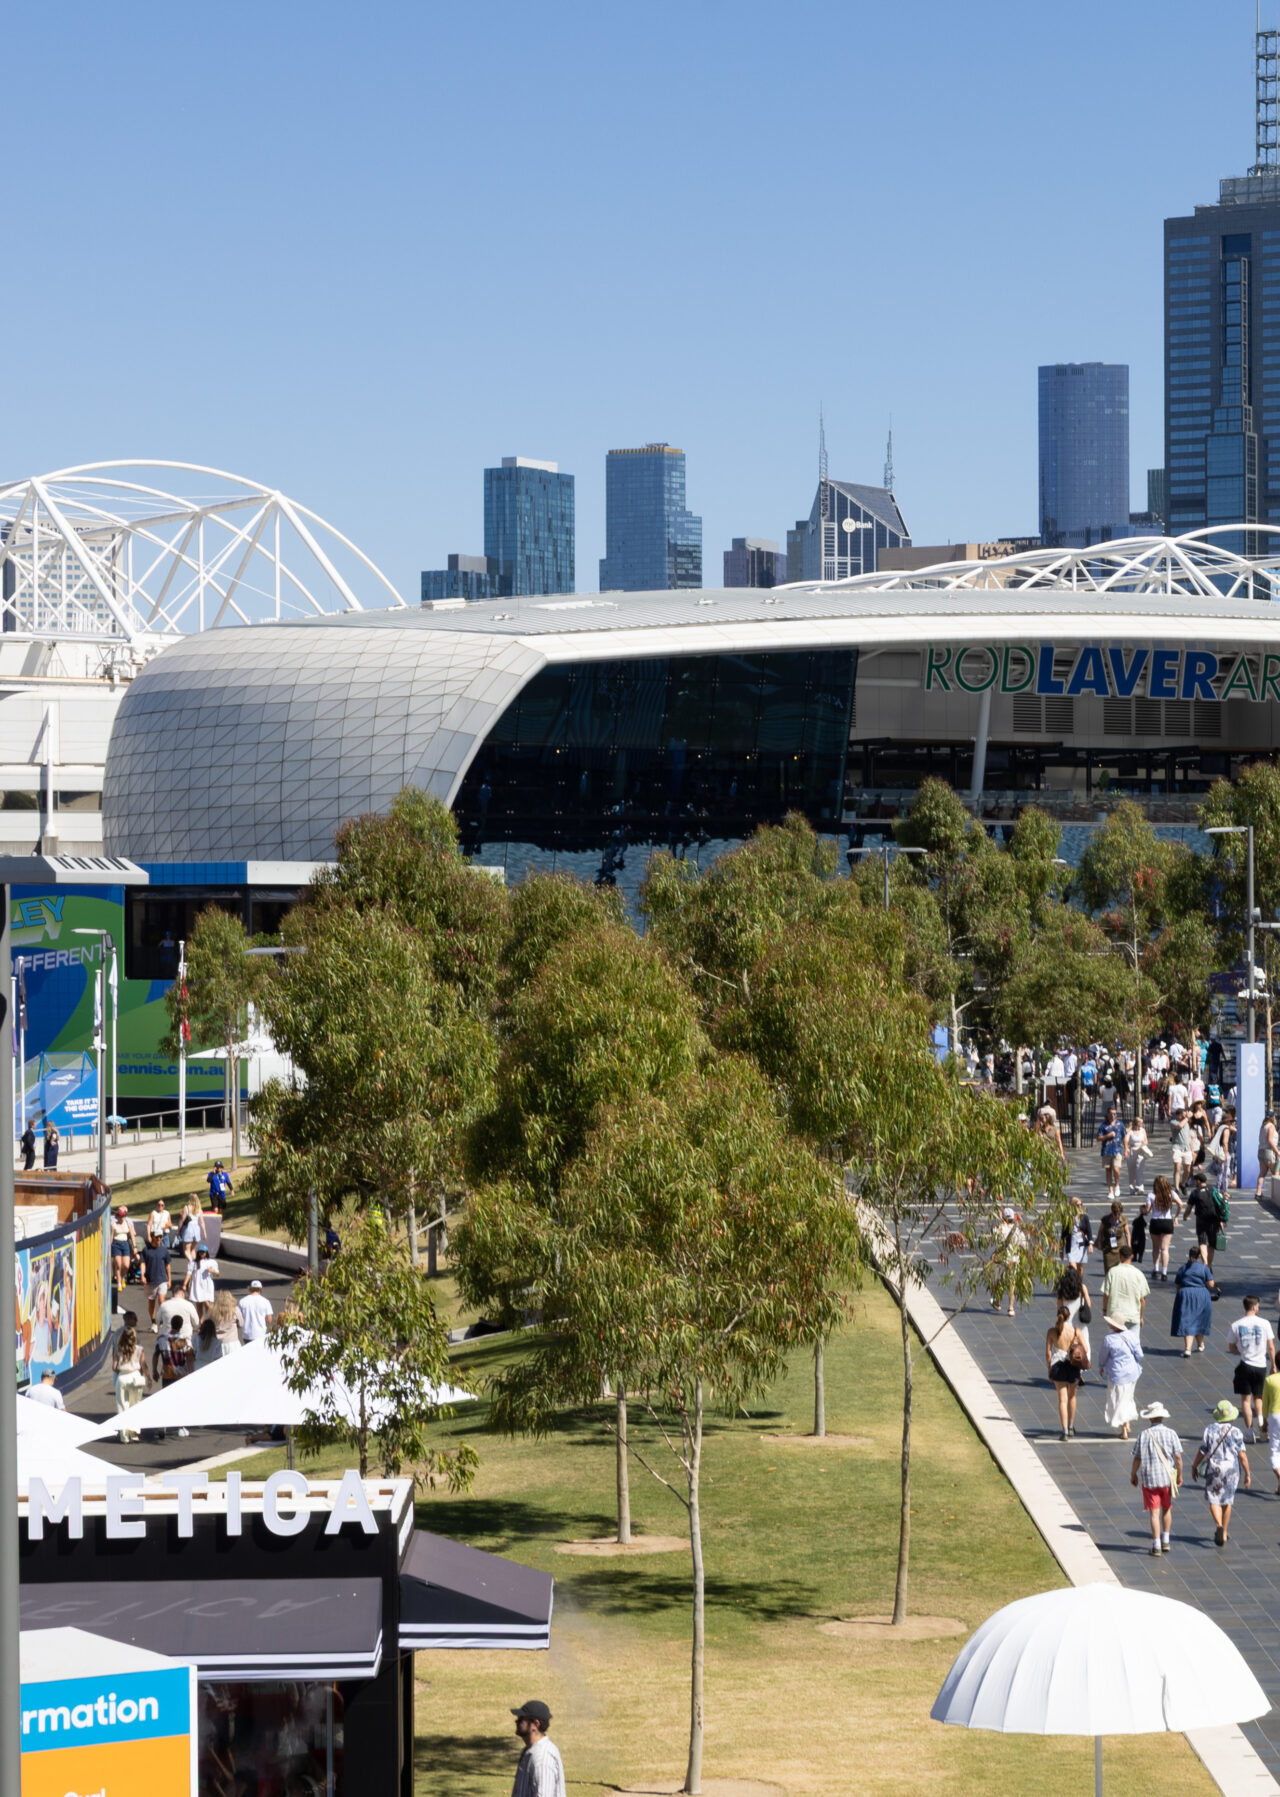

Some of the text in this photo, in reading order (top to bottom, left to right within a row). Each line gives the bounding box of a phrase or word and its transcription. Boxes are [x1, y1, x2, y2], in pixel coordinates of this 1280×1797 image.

[856, 521, 873, 529] Bank
[925, 646, 1036, 694] ROD
[1036, 646, 1220, 700] LAVER
[10, 895, 66, 931] EY
[28, 1469, 380, 1541] METICA
[21, 1692, 159, 1735] rmation
